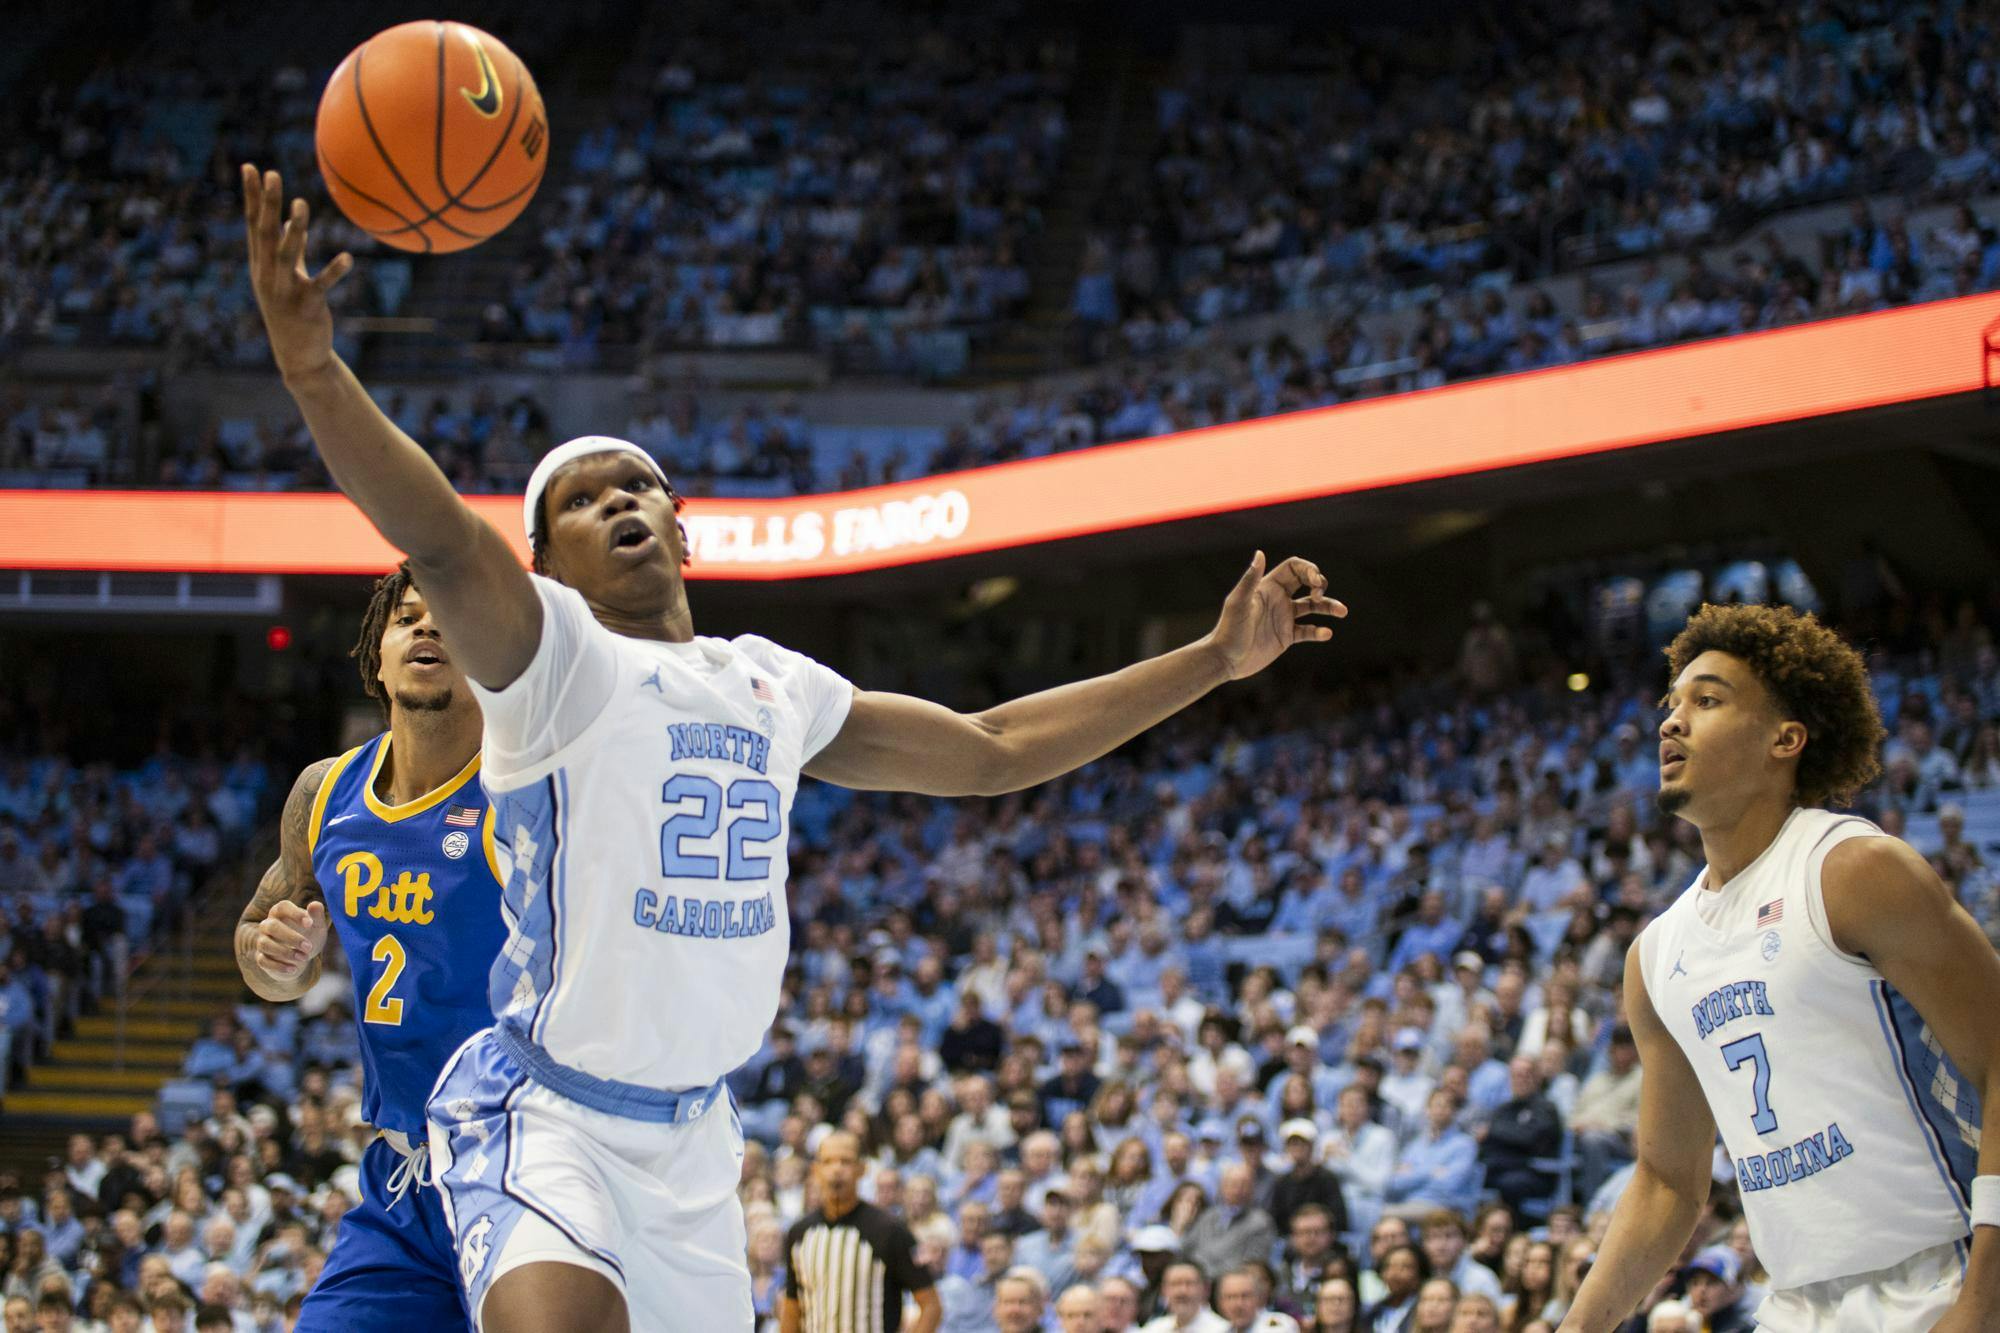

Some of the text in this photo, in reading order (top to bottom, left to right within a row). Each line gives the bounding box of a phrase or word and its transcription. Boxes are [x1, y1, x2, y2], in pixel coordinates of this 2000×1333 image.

[832, 490, 969, 556] FARGO
[667, 722, 771, 775] NORTH
[660, 773, 781, 881] 22
[336, 851, 435, 925] Pitt
[633, 888, 776, 939] CAROLINA
[364, 933, 406, 1026] 2
[1691, 980, 1775, 1040] NORTH
[1720, 1032, 1779, 1135] 7
[1737, 1122, 1854, 1193] AROLINA
